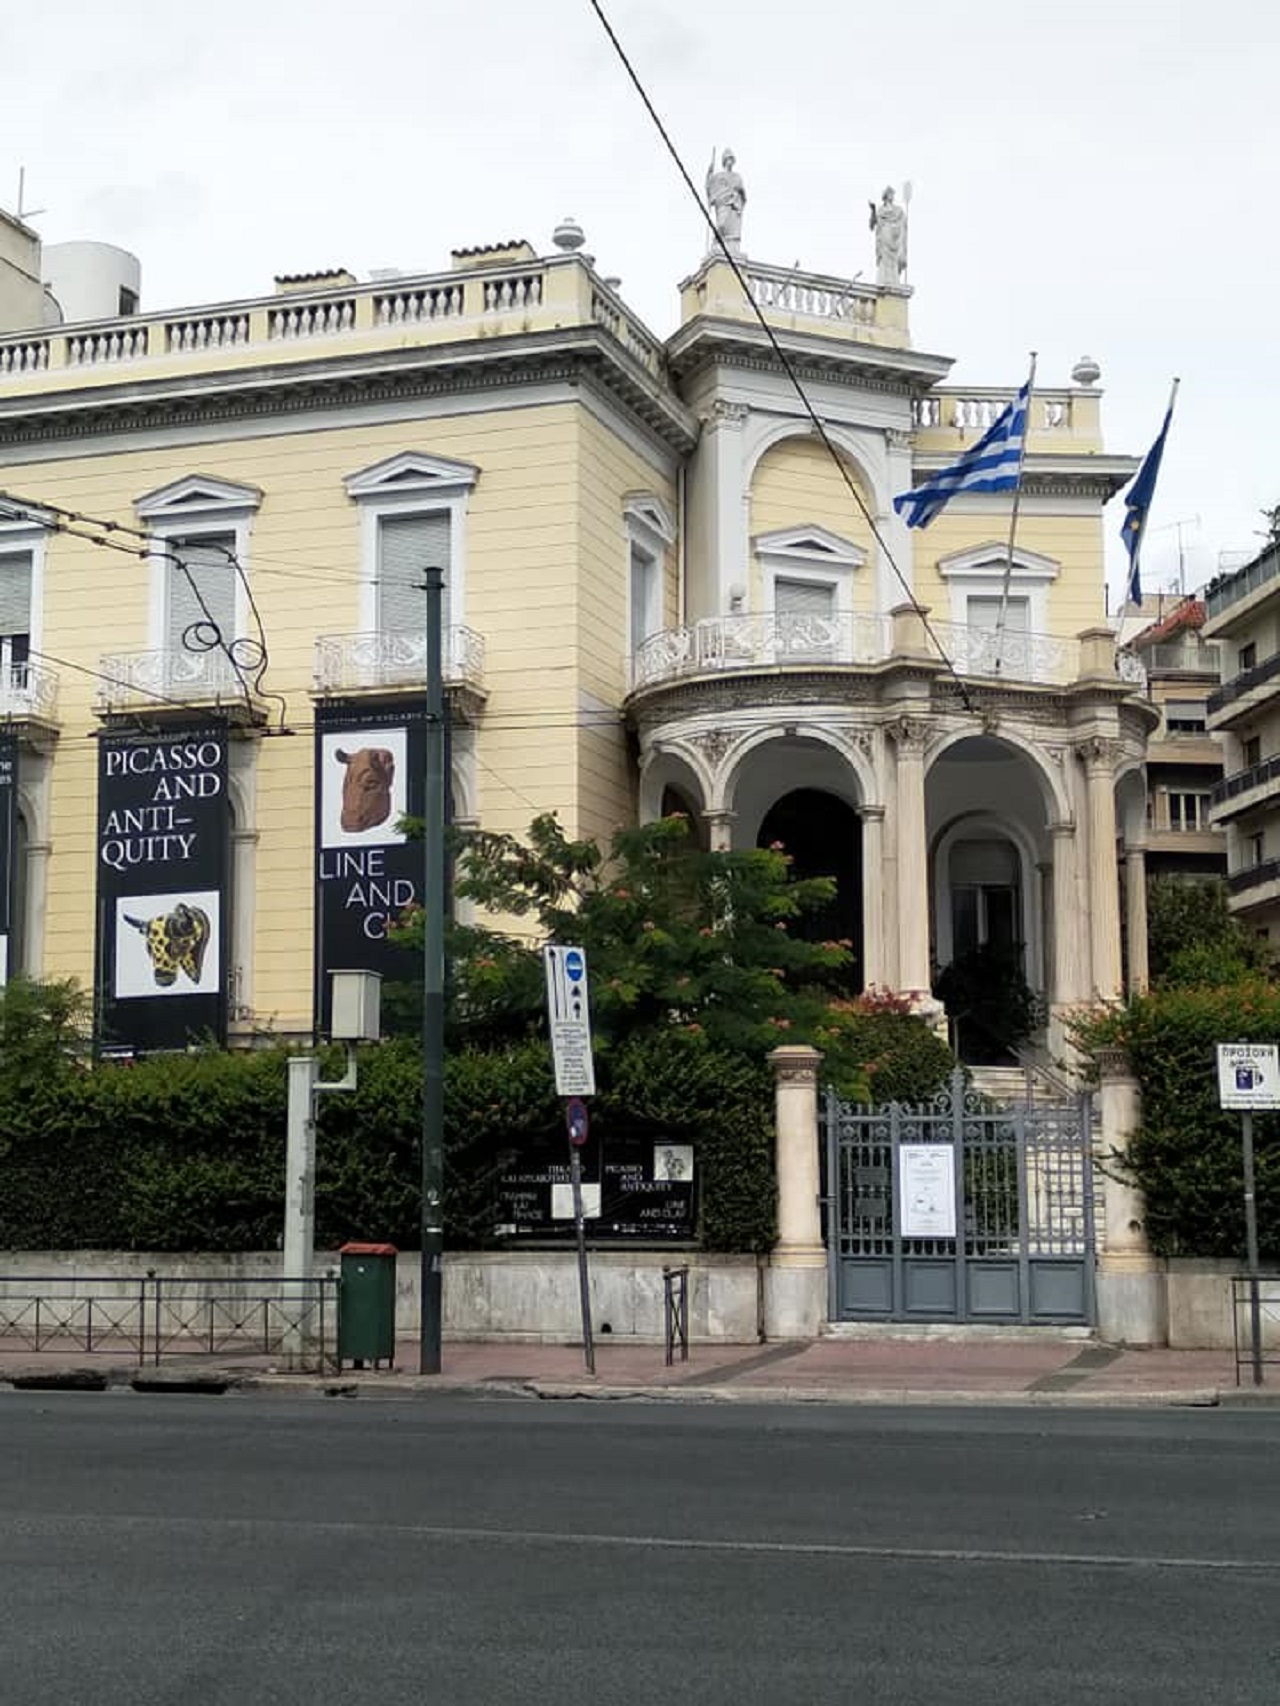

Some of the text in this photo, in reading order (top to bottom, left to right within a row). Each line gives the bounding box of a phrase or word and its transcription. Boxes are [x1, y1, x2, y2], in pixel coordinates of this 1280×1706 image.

[106, 742, 221, 776] PICASSO
[152, 772, 221, 801] AND
[101, 833, 197, 872] QUITY
[319, 849, 386, 879] LINE
[345, 879, 415, 909] AND
